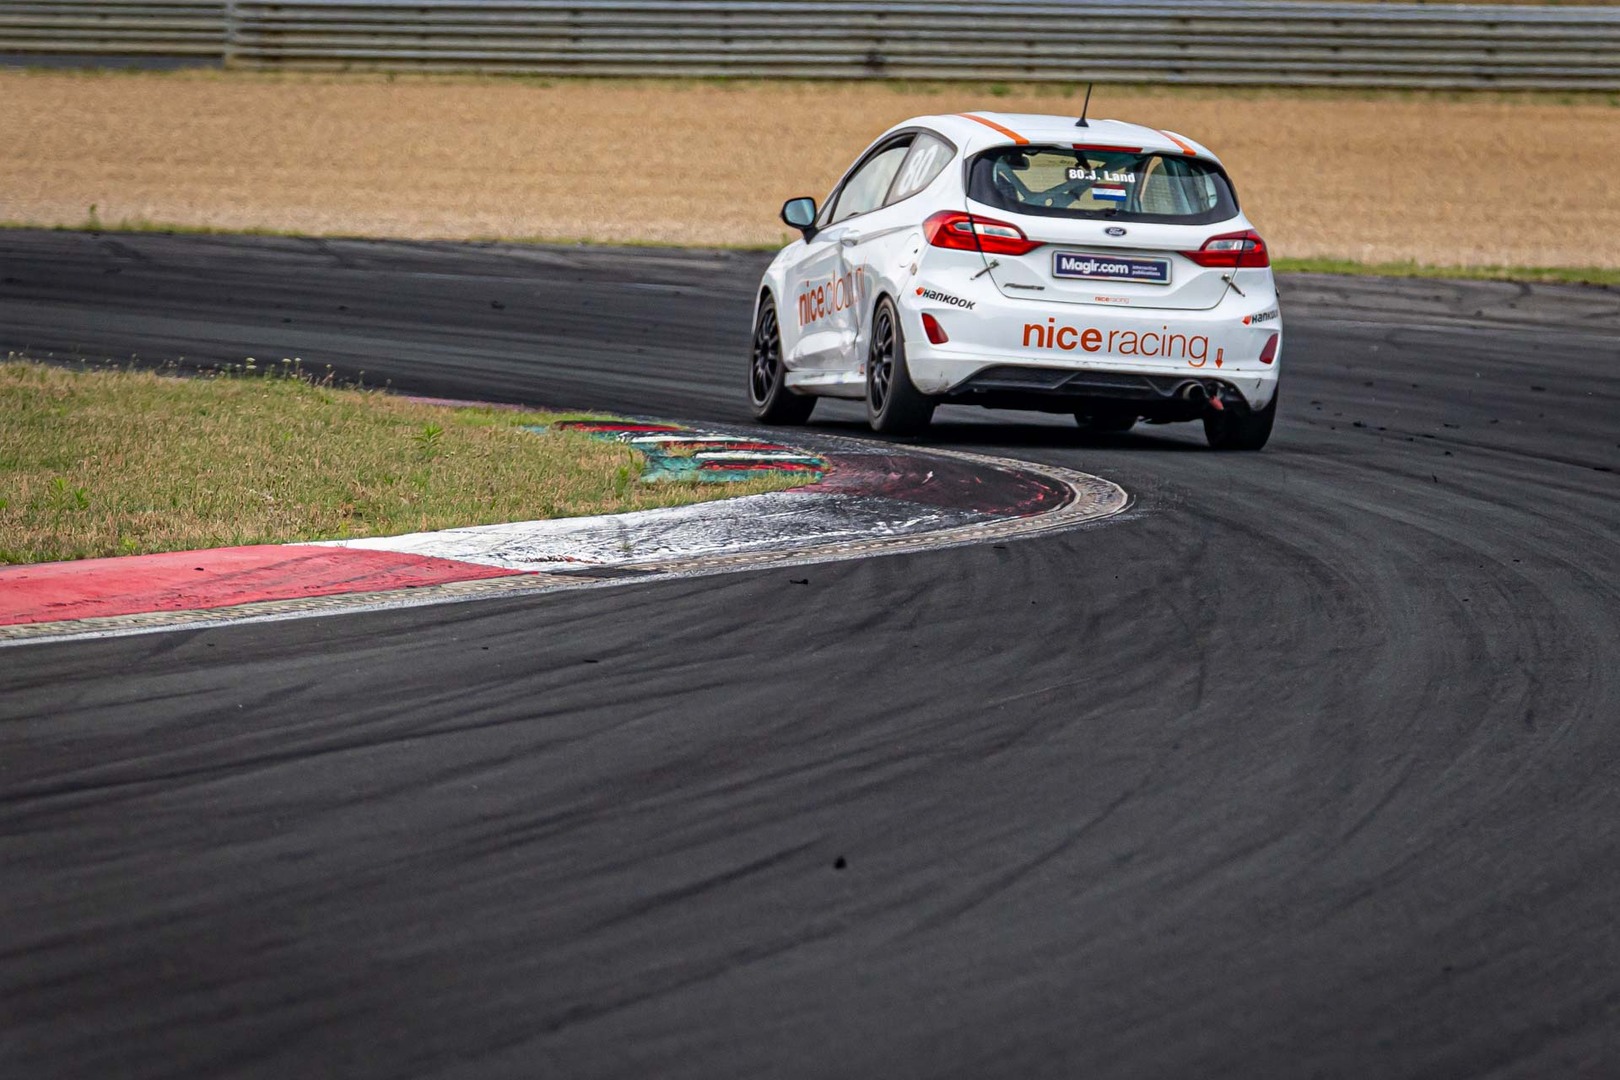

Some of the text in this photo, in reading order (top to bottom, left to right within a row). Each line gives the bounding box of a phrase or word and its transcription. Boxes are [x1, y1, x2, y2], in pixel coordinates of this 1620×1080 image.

[899, 144, 939, 196] 80
[1103, 170, 1136, 183] Land
[1061, 257, 1129, 275] Maglr.com
